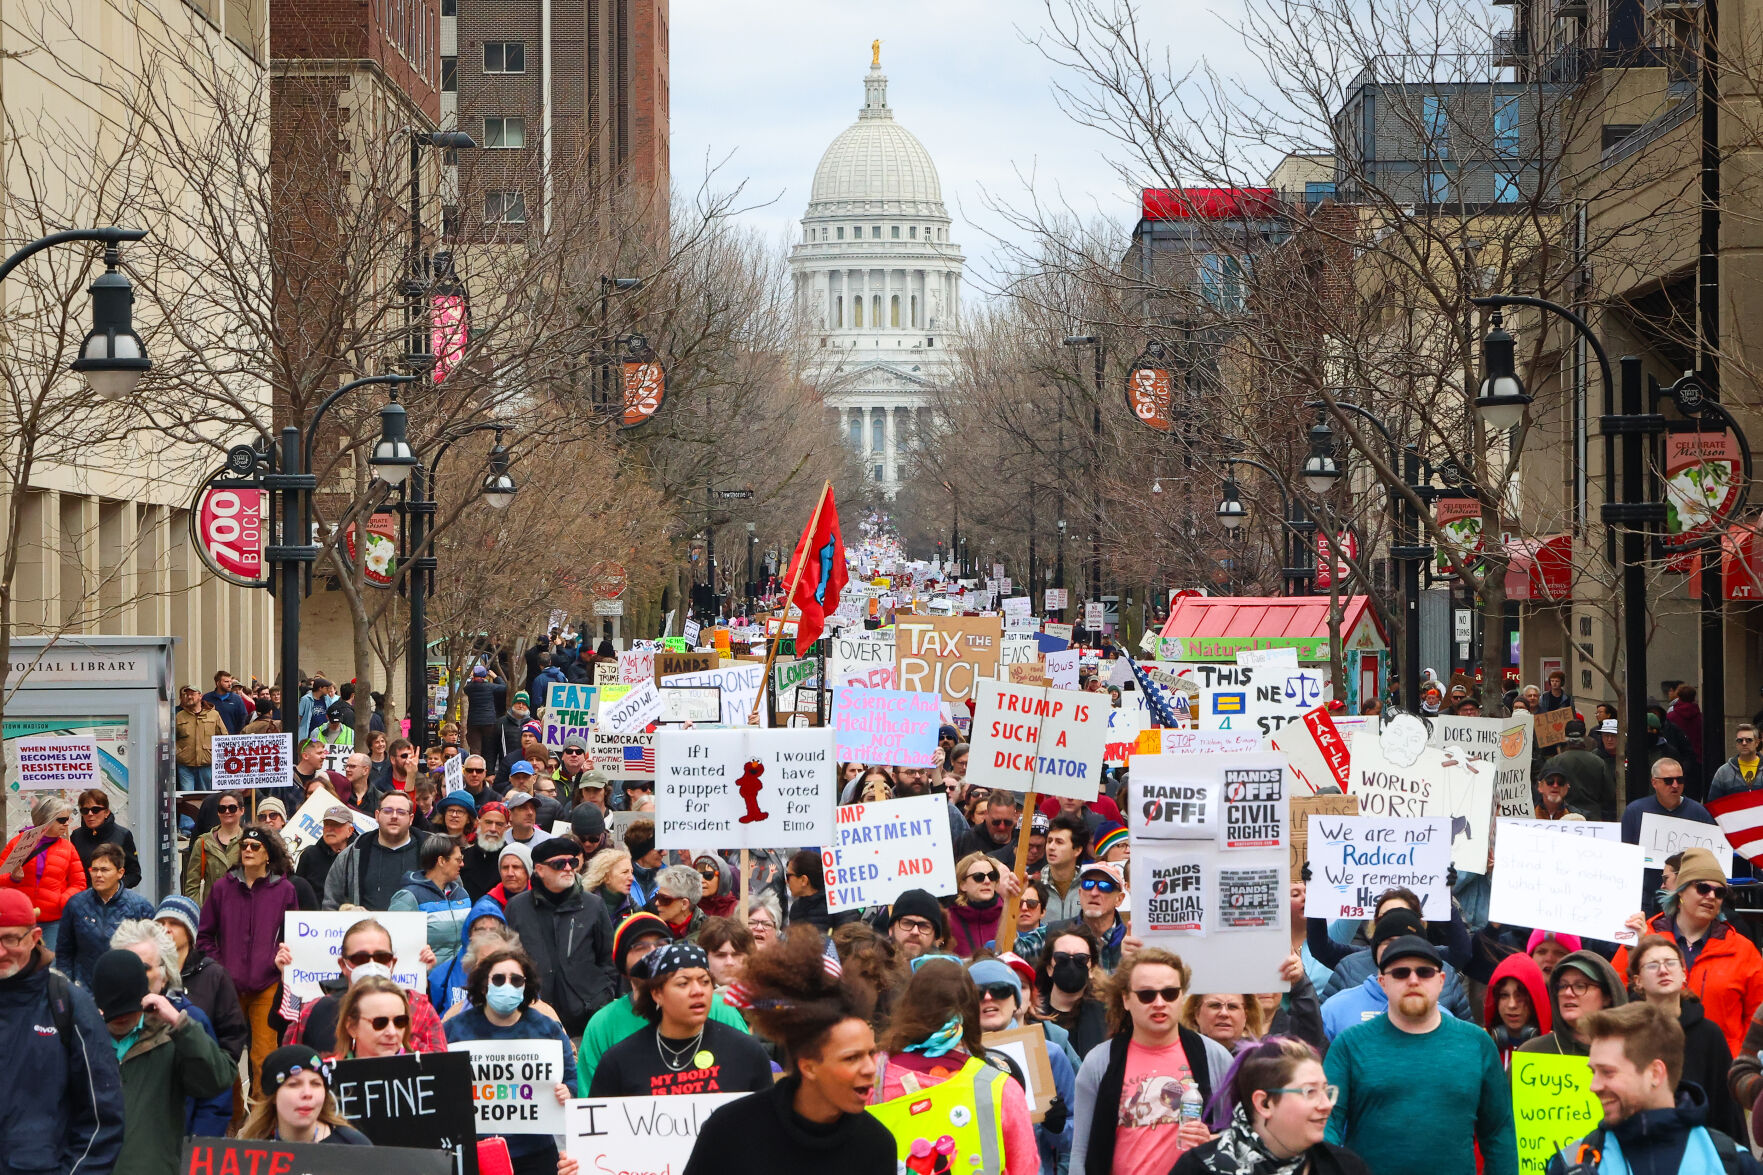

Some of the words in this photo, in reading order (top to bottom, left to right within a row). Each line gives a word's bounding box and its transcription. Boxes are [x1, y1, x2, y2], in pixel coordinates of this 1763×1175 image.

[1675, 441, 1726, 449] CELRATE
[209, 491, 240, 563] 700
[243, 505, 259, 564] BLOCK
[1458, 615, 1467, 624] NO
[898, 623, 963, 658] TAX
[966, 635, 992, 646] THE
[1456, 628, 1470, 637] TURNS
[778, 639, 817, 655] TOH
[71, 662, 136, 672] LIBRARY
[620, 654, 639, 674] Not
[663, 658, 709, 673] HANDS
[777, 661, 815, 691] LOVE?
[900, 658, 998, 700] RICH
[1152, 671, 1181, 687] ELON
[1197, 665, 1253, 688] THIS
[551, 685, 597, 710] EAT
[837, 688, 907, 712] Science
[909, 694, 939, 713] And
[997, 692, 1064, 718] TRUMP
[1074, 704, 1090, 723] IS
[556, 710, 589, 726] THE
[835, 711, 930, 735] Healthcare
[871, 733, 905, 748] NOT
[990, 720, 1038, 743] SUCH
[1055, 730, 1067, 748] A
[1166, 733, 1197, 748] STOP
[1444, 725, 1472, 743] DOES
[1476, 729, 1498, 745] THIS
[48, 745, 91, 753] INJUSTICE
[223, 744, 281, 757] HANDS
[241, 740, 256, 748] RIGHT
[687, 745, 701, 758] If
[704, 747, 708, 758] I
[20, 754, 67, 762] BECOMES
[69, 753, 91, 761] LAW
[776, 751, 780, 762] I
[783, 749, 826, 762] would
[836, 744, 884, 762] Tariffs
[22, 762, 93, 772] RESISTENCE
[223, 755, 281, 774] OFF!
[602, 764, 620, 773] FOR!
[671, 764, 725, 777] wanted
[993, 750, 1088, 779] DICKTATOR
[22, 773, 65, 781] BECOMES
[242, 777, 254, 785] OUR
[255, 776, 288, 784] DEMOCRACY!
[782, 768, 815, 780] have
[1227, 770, 1280, 783] HANDS
[666, 783, 675, 794] a
[679, 783, 729, 798] puppet
[778, 784, 820, 797] voted
[1143, 785, 1207, 800] HANDS
[1227, 782, 1281, 801] OFF!
[1361, 770, 1432, 798] WORLD'S
[685, 799, 710, 813] for
[787, 801, 811, 814] for
[836, 804, 865, 824] MP
[1143, 799, 1206, 825] OFF!
[1227, 804, 1281, 825] CIVIL
[299, 813, 324, 840] THE
[663, 818, 731, 833] president
[783, 819, 815, 832] Elmo
[836, 819, 932, 846] PARTMENT
[1227, 825, 1280, 840] RIGHTS
[1319, 820, 1354, 841] We
[1364, 828, 1396, 843] are
[1404, 824, 1438, 843] not
[822, 849, 842, 868] OF
[1342, 844, 1415, 866] Radical
[824, 863, 879, 886] GREED
[898, 858, 934, 877] AND
[1152, 864, 1201, 879] HANDS
[1325, 865, 1354, 885] We
[1362, 871, 1439, 886] remember
[1152, 875, 1201, 898] OFF!
[1230, 885, 1268, 894] HANDS
[828, 886, 865, 906] EVIL
[1148, 896, 1204, 913] SOCIAL
[1230, 893, 1268, 907] OFF!
[1357, 887, 1429, 909] Hisy
[1148, 910, 1204, 924] SECURITY
[1340, 905, 1365, 917] 1933
[298, 922, 319, 938] Do
[324, 924, 345, 938] not
[292, 968, 341, 985] PROTECT
[469, 1054, 483, 1062] EEP
[485, 1054, 506, 1062] YOUR
[507, 1053, 540, 1062] BIGOTED
[521, 1062, 553, 1081] OFF
[650, 1073, 675, 1088] MY
[676, 1065, 721, 1084] BODY
[1519, 1062, 1580, 1096] Guys,
[472, 1084, 533, 1101] LGBTQ
[670, 1083, 704, 1096] NOT
[706, 1079, 720, 1091] A
[577, 1103, 609, 1137] I
[622, 1100, 714, 1137] Woul
[1520, 1101, 1592, 1121] worried
[1519, 1136, 1546, 1150] our
